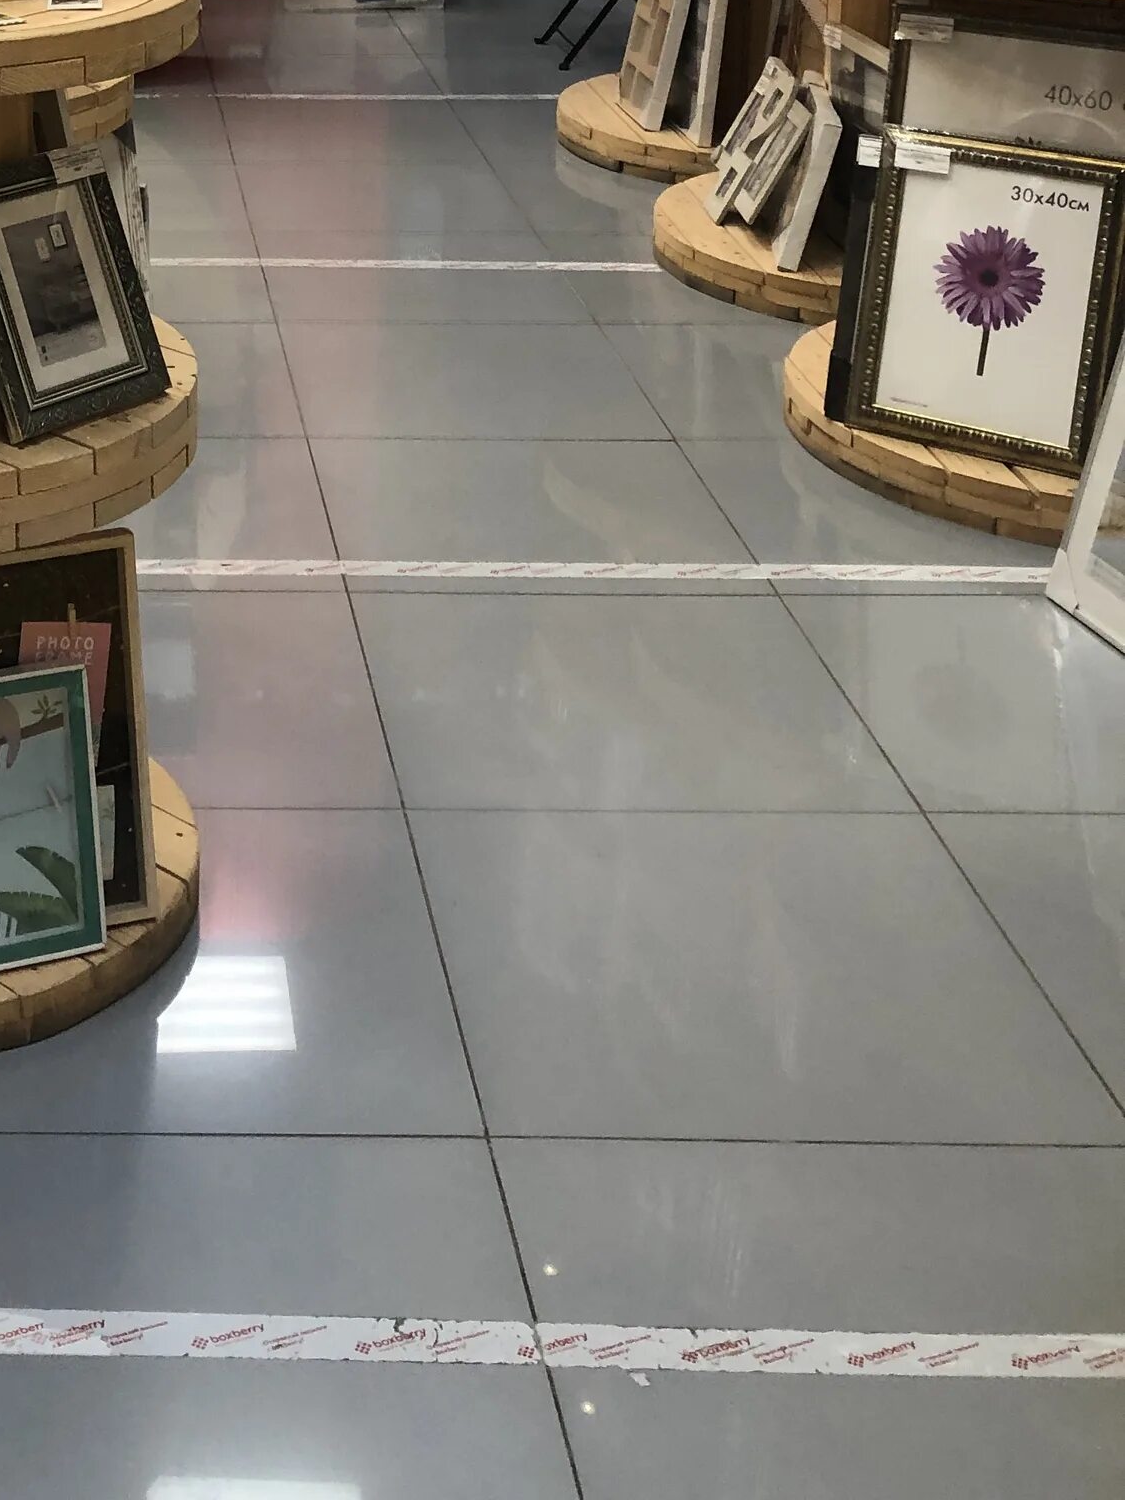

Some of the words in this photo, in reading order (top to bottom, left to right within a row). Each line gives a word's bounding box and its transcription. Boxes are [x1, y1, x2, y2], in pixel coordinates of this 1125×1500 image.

[1044, 84, 1113, 111] 40x60
[36, 635, 95, 651] PHOTO
[209, 1323, 265, 1344] boxberry
[863, 1340, 916, 1362] boxberry
